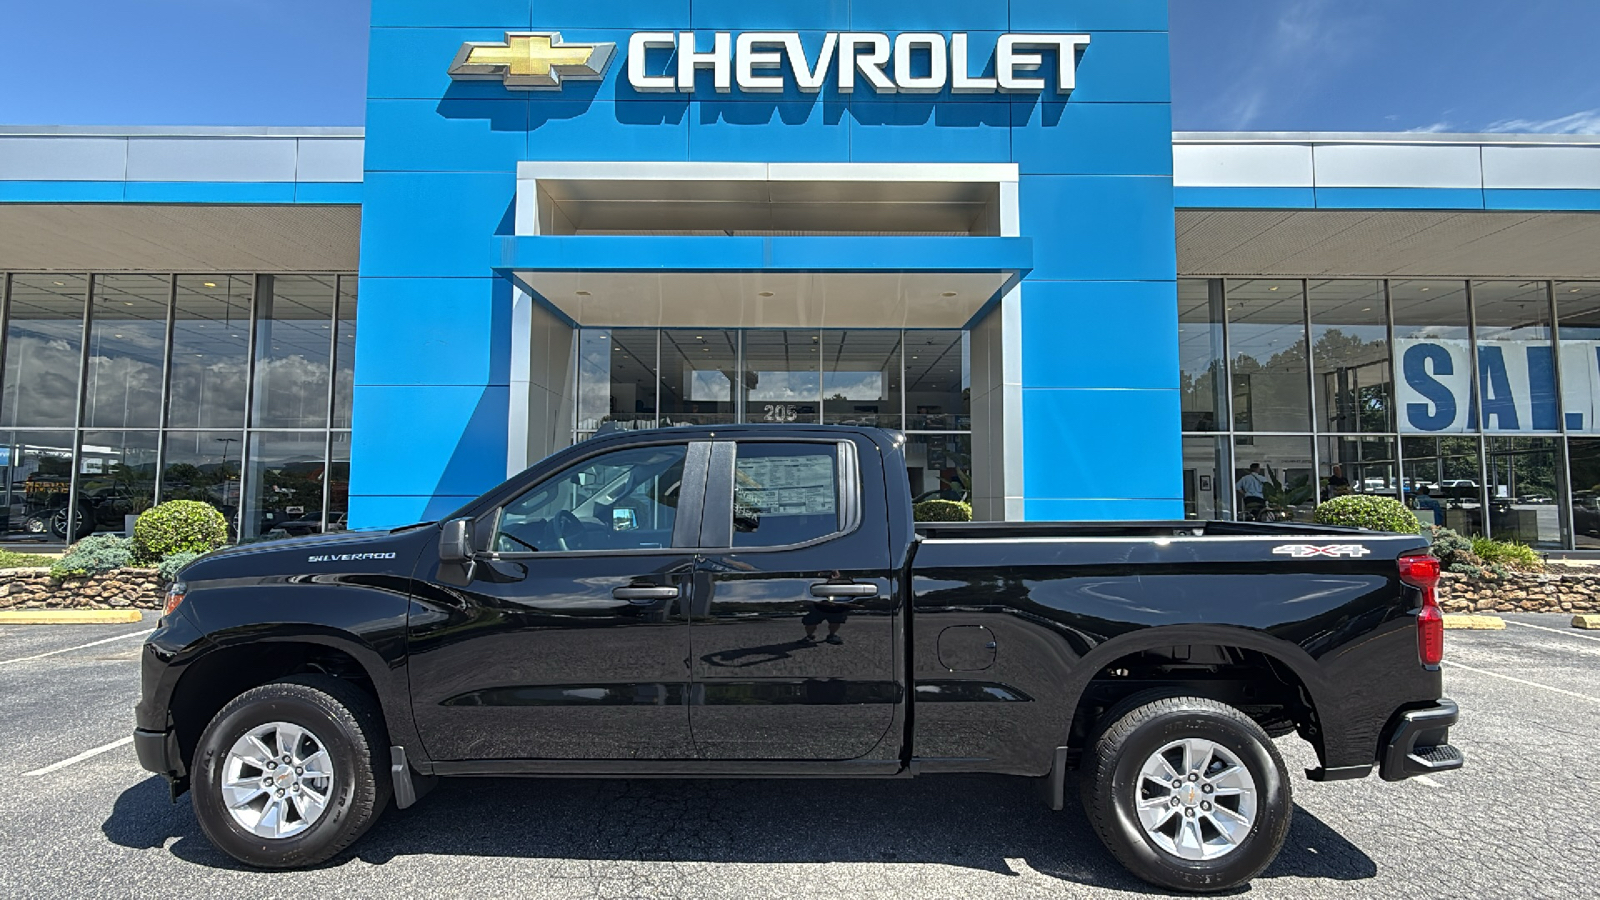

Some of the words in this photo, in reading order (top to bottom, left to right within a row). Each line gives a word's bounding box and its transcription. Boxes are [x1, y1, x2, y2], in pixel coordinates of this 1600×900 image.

[628, 32, 1091, 94] CHEVROLET
[764, 404, 797, 421] 205
[308, 552, 396, 563] SILVERADO
